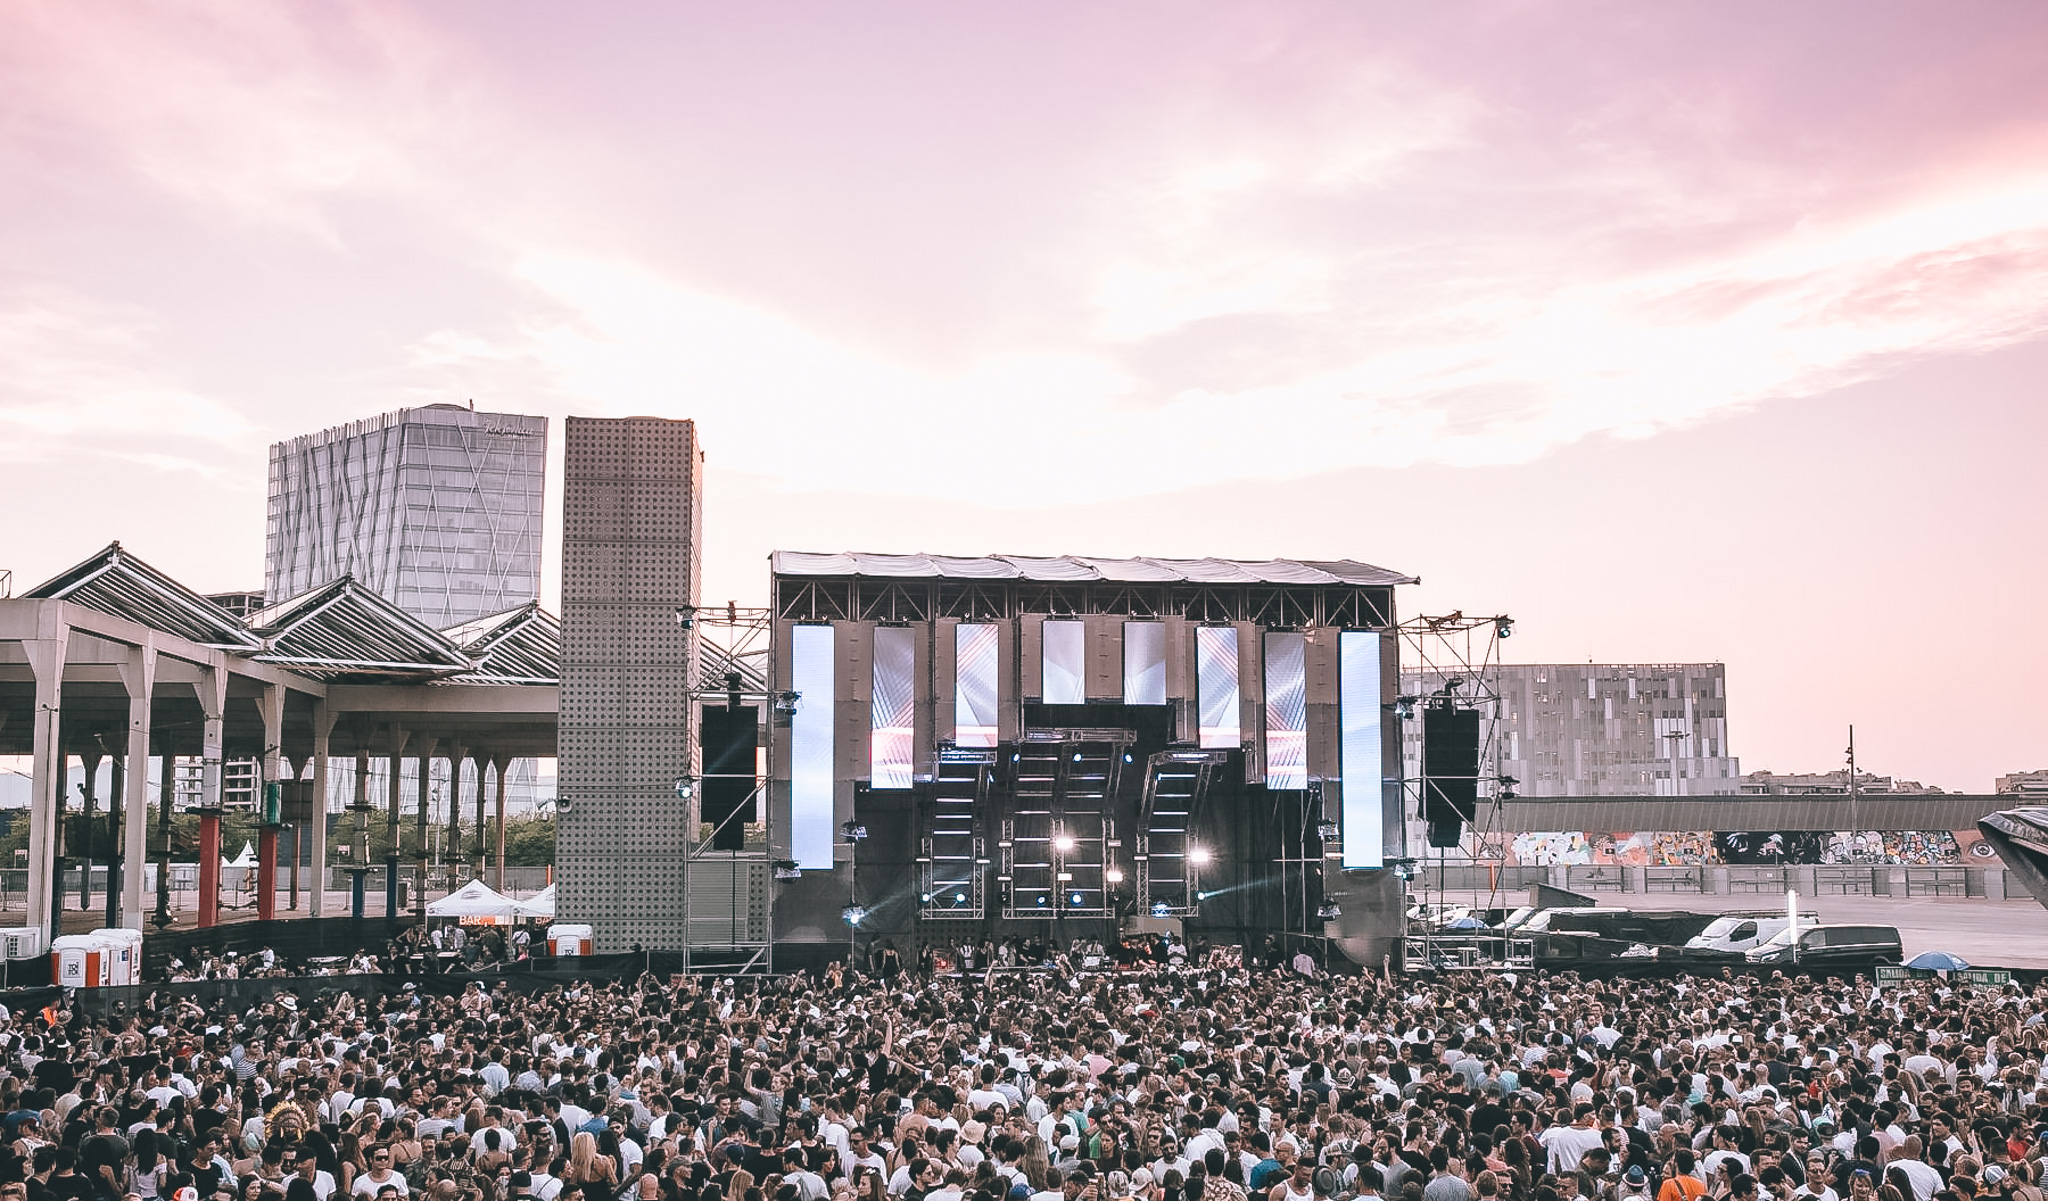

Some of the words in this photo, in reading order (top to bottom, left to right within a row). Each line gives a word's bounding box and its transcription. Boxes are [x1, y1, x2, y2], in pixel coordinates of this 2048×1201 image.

[459, 915, 481, 925] BAR
[1880, 968, 1911, 979] SALIDA
[1957, 972, 1988, 983] SALIDA
[1994, 973, 2007, 983] DE
